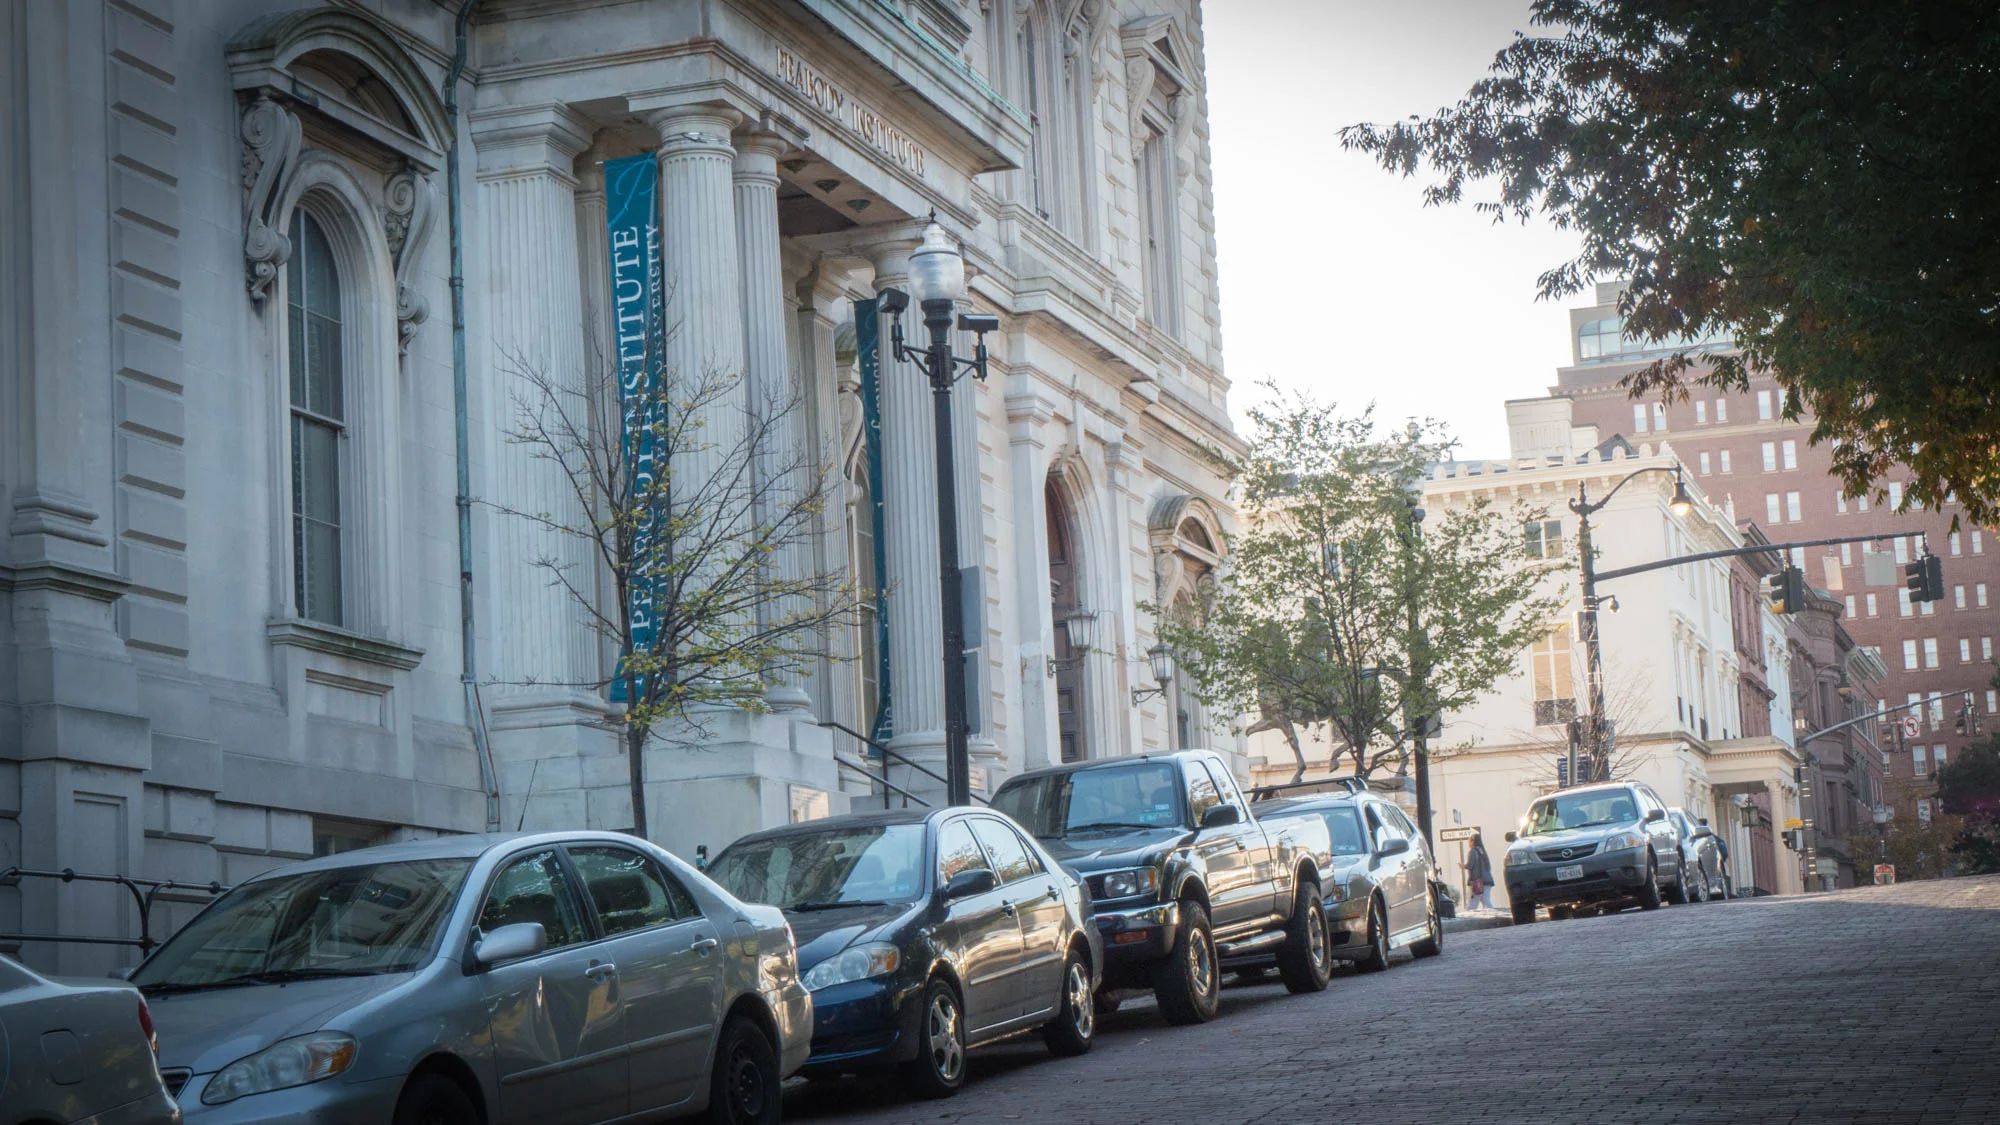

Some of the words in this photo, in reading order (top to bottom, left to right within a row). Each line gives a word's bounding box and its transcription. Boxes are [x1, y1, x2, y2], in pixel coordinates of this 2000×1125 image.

[775, 45, 844, 122] PEABODY
[851, 102, 925, 178] INSTITUTE
[645, 224, 664, 375] UNIVERSITY
